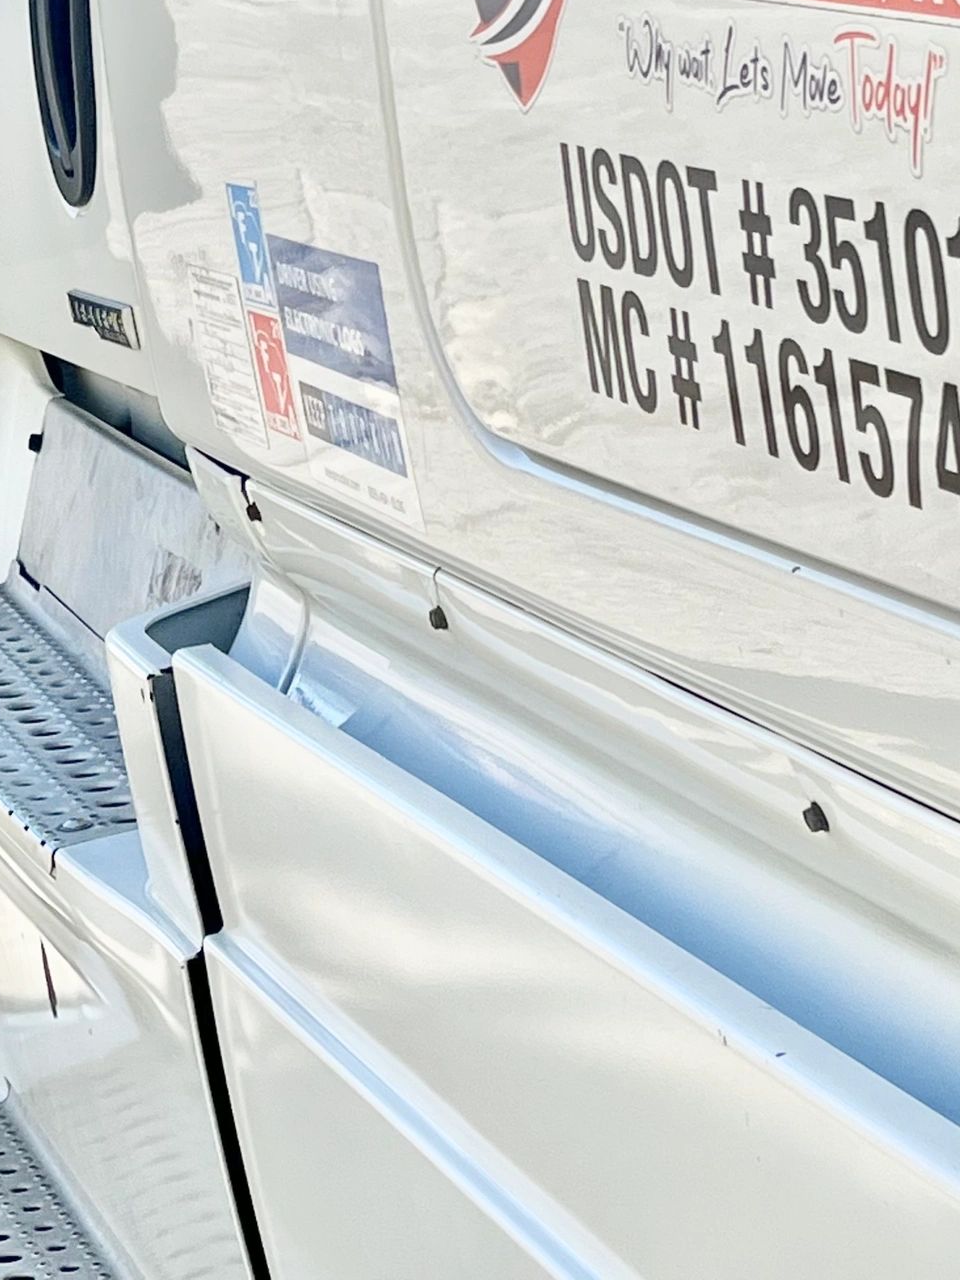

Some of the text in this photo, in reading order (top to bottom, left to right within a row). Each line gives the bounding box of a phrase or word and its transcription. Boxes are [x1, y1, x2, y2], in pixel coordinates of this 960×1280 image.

[780, 41, 841, 111] Move
[560, 142, 721, 296] USDOT
[739, 179, 776, 309] #
[577, 277, 960, 511] MC # 1161574
